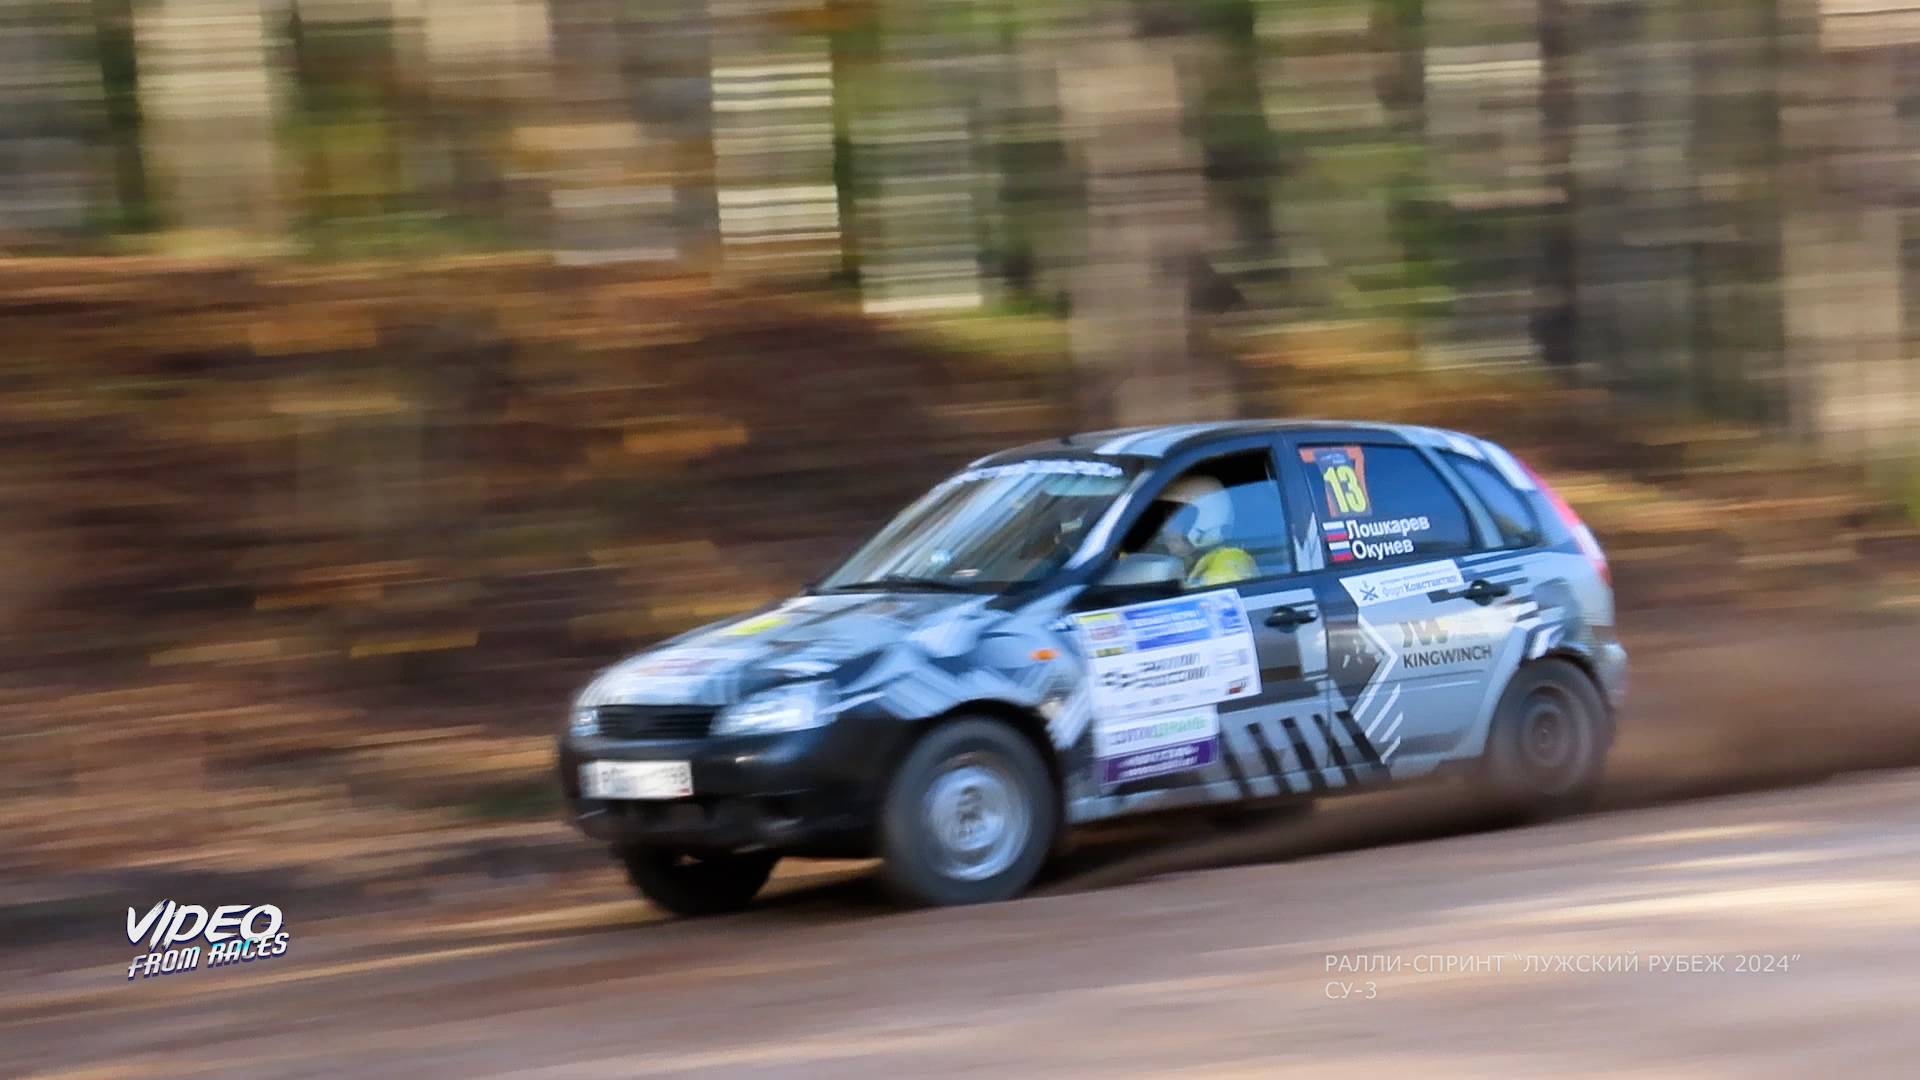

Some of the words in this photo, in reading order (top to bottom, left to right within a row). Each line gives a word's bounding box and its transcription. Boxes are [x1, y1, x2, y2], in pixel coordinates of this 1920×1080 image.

[1323, 465, 1367, 513] 13
[1346, 517, 1430, 539] Лошкарев
[1352, 539, 1414, 560] Окунев
[1403, 645, 1492, 669] KINGWINCH
